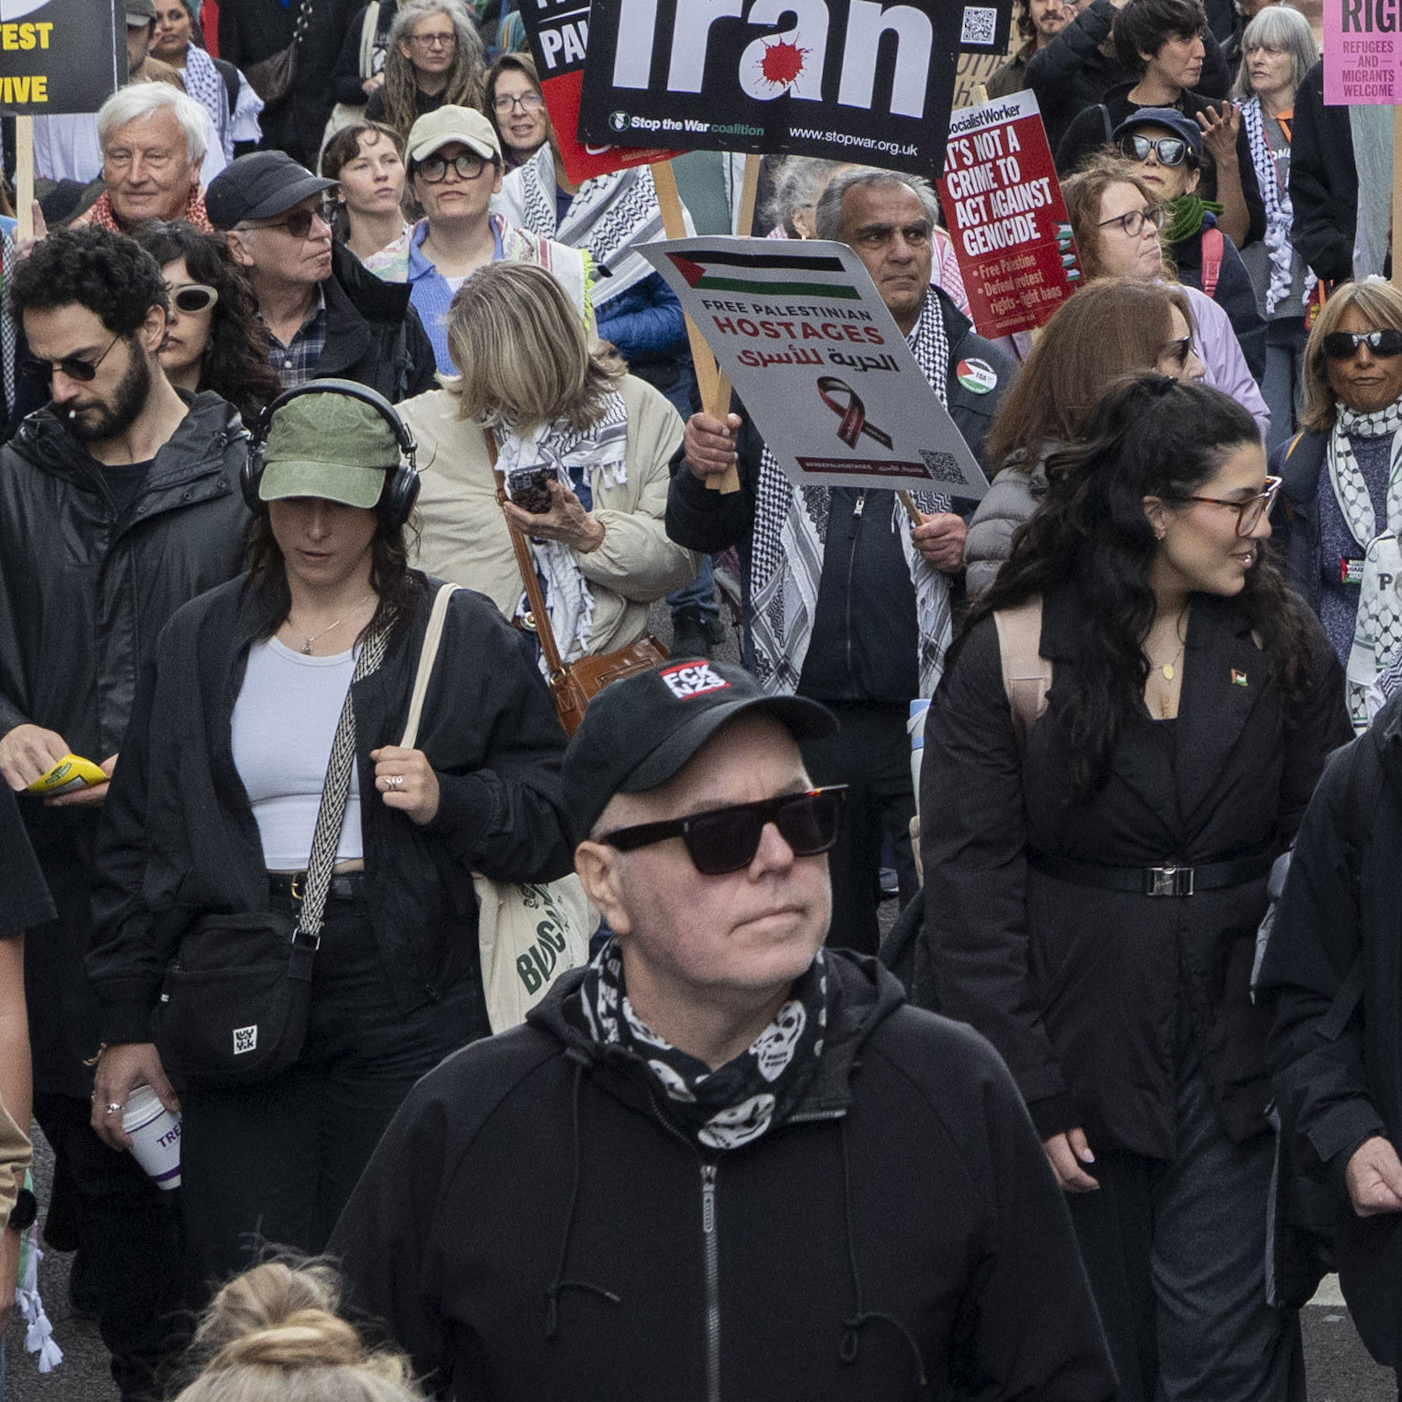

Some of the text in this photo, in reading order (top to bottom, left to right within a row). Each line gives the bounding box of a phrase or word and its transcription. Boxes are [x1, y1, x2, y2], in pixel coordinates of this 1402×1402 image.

[1343, 41, 1394, 53] REFUGEES
[1358, 56, 1378, 67] AND
[1342, 70, 1395, 82] MIGRANTS
[1344, 85, 1393, 97] WELCOME
[631, 116, 918, 156] Stop the War coalition www.stopwar.org.uk
[975, 125, 1021, 162] NOT A
[947, 155, 1021, 200] CRIME TO
[955, 177, 1053, 229] ACT AGAINST
[961, 213, 1041, 257] GENOCIDE
[979, 263, 999, 280] Free
[702, 299, 873, 322] FREE PALESTINIAN
[713, 316, 885, 345] HOSTAGES
[737, 344, 900, 372] الحرية للأسرى
[662, 664, 718, 691] FCK
